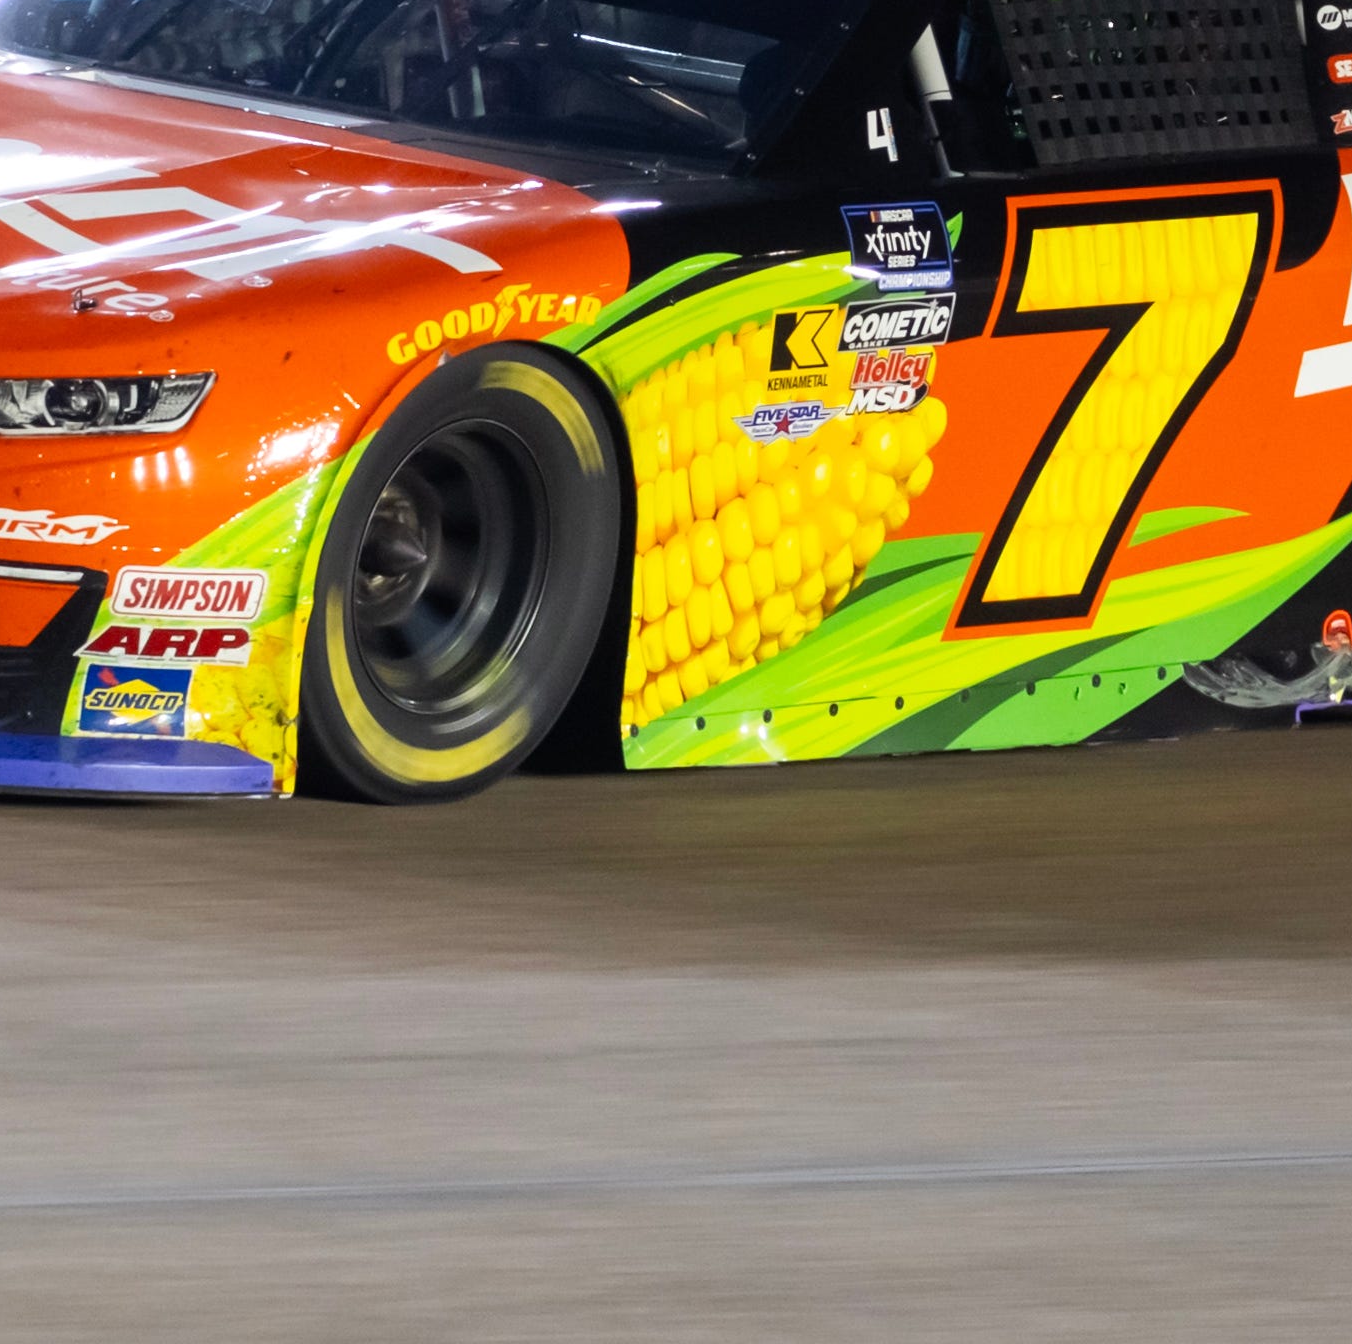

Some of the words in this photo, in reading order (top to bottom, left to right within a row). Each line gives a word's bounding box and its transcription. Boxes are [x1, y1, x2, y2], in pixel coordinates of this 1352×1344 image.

[866, 107, 899, 162] 4
[864, 224, 931, 261] xfinity
[887, 255, 916, 268] SERIES
[387, 283, 602, 365] GOODYEAR
[843, 306, 950, 343] COMETIC
[848, 339, 890, 350] GASKET
[767, 373, 828, 392] KENNAMETAL
[851, 351, 931, 389] Holley
[752, 408, 786, 425] FIVE
[788, 405, 821, 419] STAR
[846, 385, 916, 414] MSD
[955, 190, 1275, 628] 7
[123, 577, 253, 613] SIMPSON
[85, 625, 250, 657] ARP
[90, 691, 180, 711] SUNOCO
